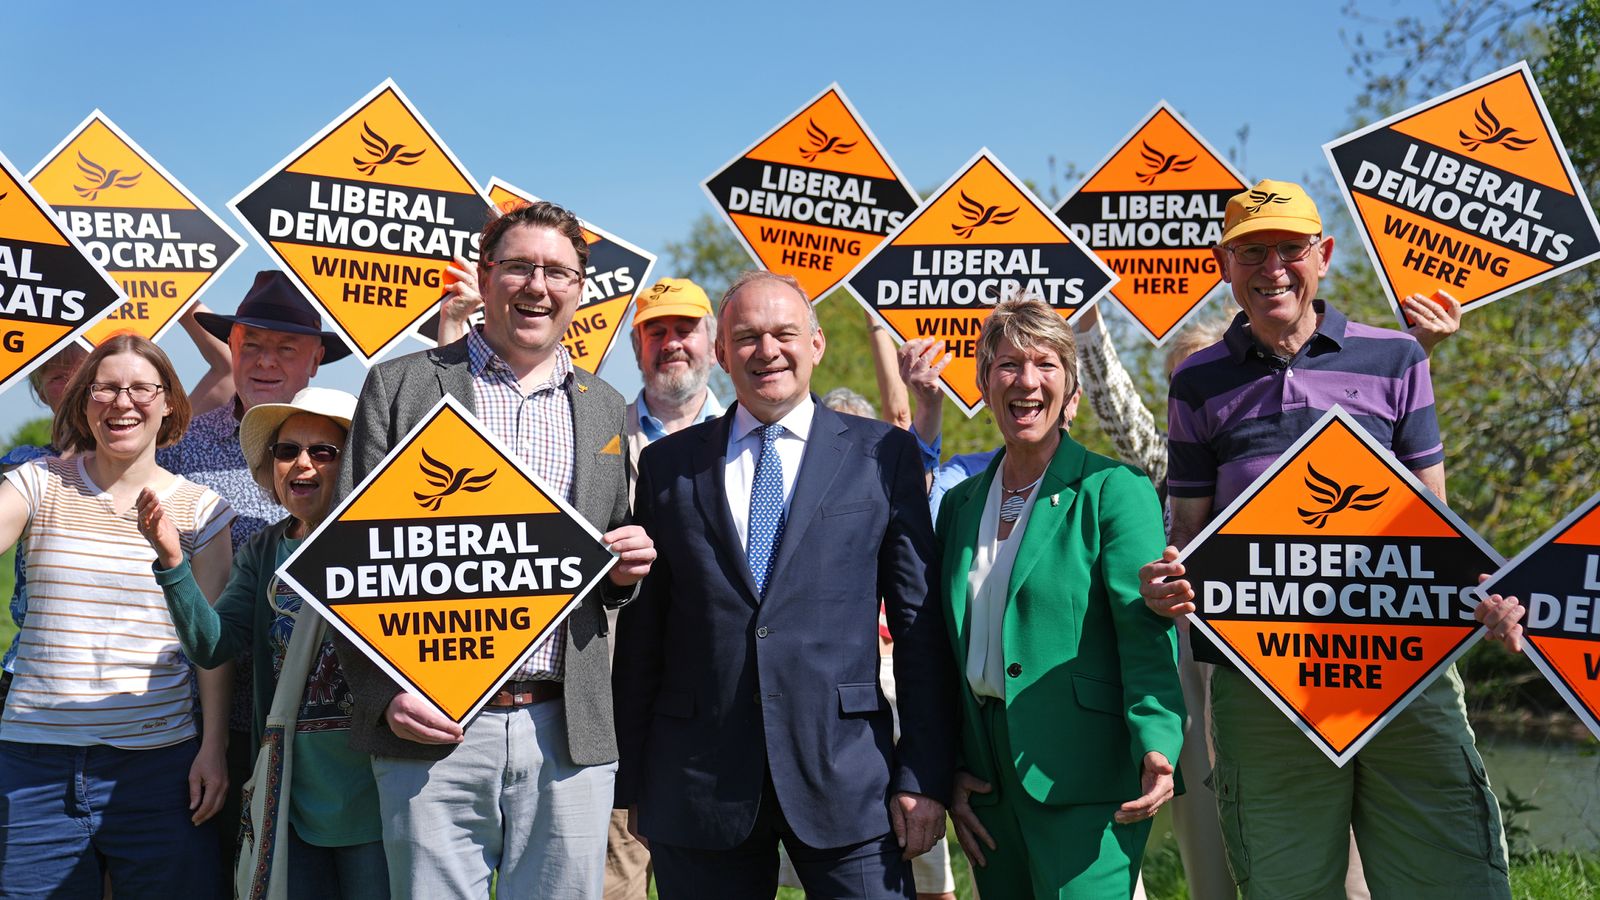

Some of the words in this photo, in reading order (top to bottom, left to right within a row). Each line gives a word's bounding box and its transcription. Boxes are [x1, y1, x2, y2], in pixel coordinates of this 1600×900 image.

[761, 165, 877, 205] LIBERAL
[1401, 143, 1543, 220] LIBERAL
[309, 180, 454, 225] LIBERAL
[728, 186, 905, 234] DEMOCRATS
[1101, 194, 1225, 220] LIBERAL
[1353, 160, 1575, 262] DEMOCRATS
[268, 208, 480, 260] DEMOCRATS
[760, 226, 861, 256] WINNING
[1070, 221, 1224, 247] DEMOCRA
[1383, 214, 1510, 277] WINNING
[83, 241, 218, 269] OCRATS
[781, 249, 833, 271] HERE
[912, 248, 1049, 276] LIBERAL
[1106, 257, 1216, 274] WINNING
[1402, 248, 1471, 288] HERE
[311, 255, 440, 288] WINNING
[1134, 278, 1189, 294] HERE
[342, 282, 408, 308] HERE
[876, 277, 1085, 306] DEMOCRATS
[915, 317, 982, 336] WINN
[944, 340, 976, 358] HE
[368, 521, 538, 560] LIBERAL
[1249, 542, 1435, 579] LIBERAL
[325, 556, 583, 600] DEMOCRATS
[1203, 580, 1480, 621] DEMOCRATS
[379, 606, 531, 637] WINNING
[418, 636, 495, 663] HERE
[1256, 632, 1424, 662] WINNING
[1298, 662, 1383, 690] HERE
